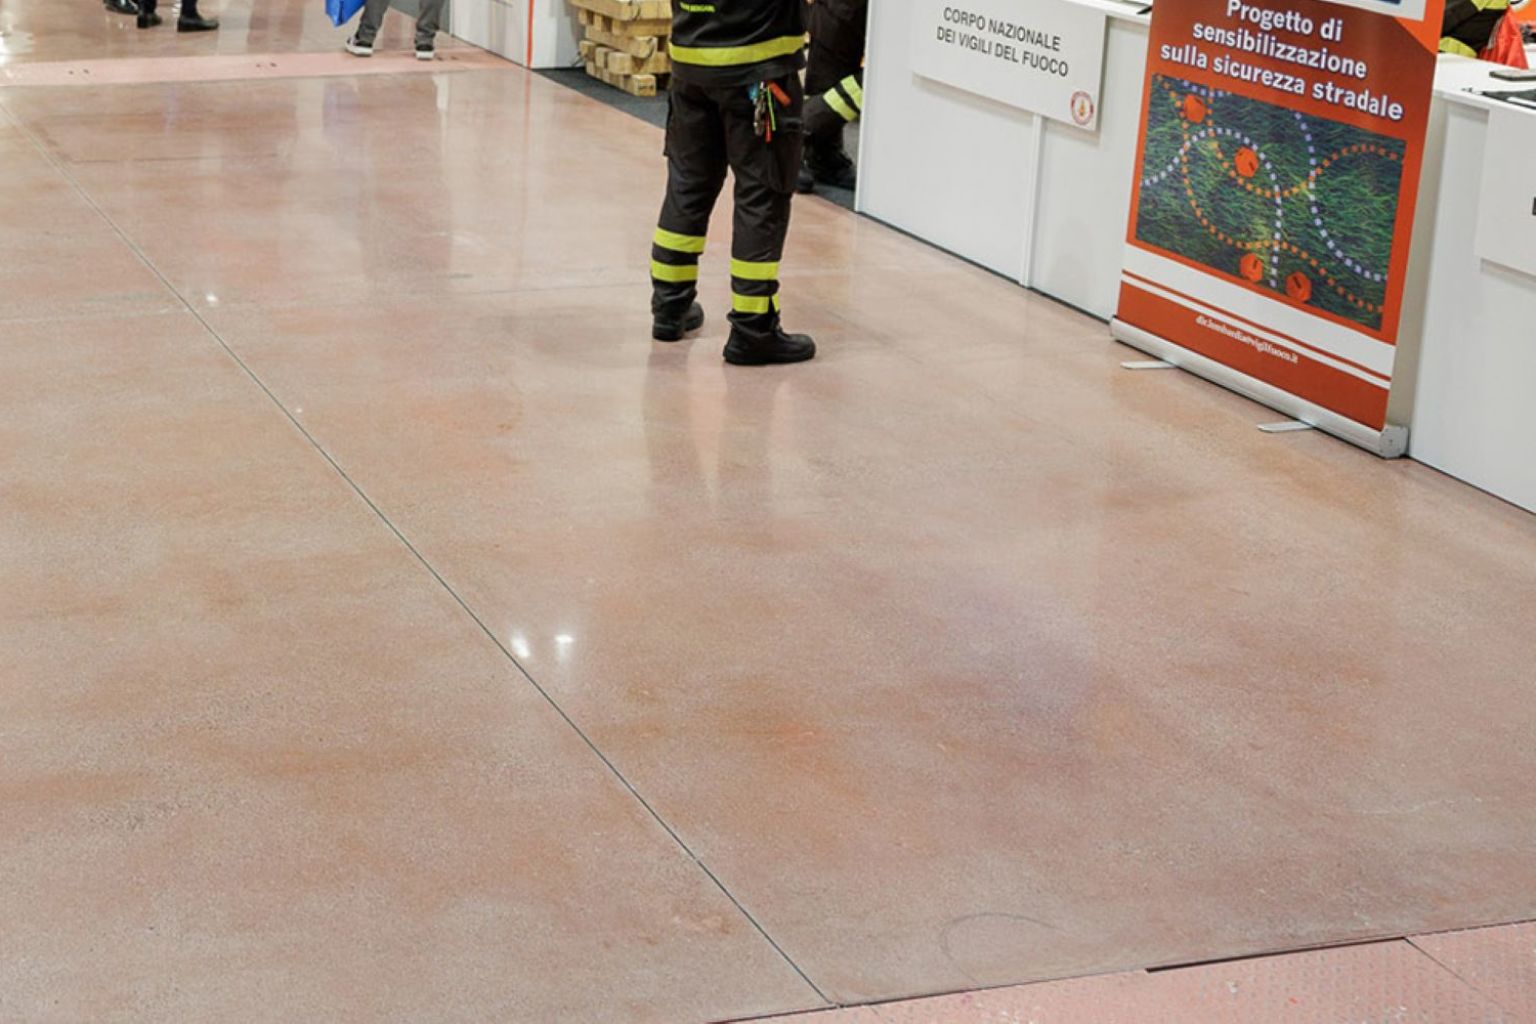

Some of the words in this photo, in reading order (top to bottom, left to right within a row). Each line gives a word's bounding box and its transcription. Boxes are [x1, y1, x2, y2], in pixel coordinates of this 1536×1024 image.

[936, 26, 955, 43] DEI
[959, 31, 992, 55] VIGILI
[995, 41, 1019, 63] DEL
[1022, 51, 1069, 77] FUOCO
[943, 6, 985, 31] CORPO
[988, 19, 1061, 52] NAZIONALE
[1193, 21, 1367, 78] sensibilizzazione
[1320, 18, 1342, 42] di
[1160, 43, 1208, 69] sulla
[1213, 55, 1306, 95] sicurezza
[1312, 81, 1404, 121] stradale
